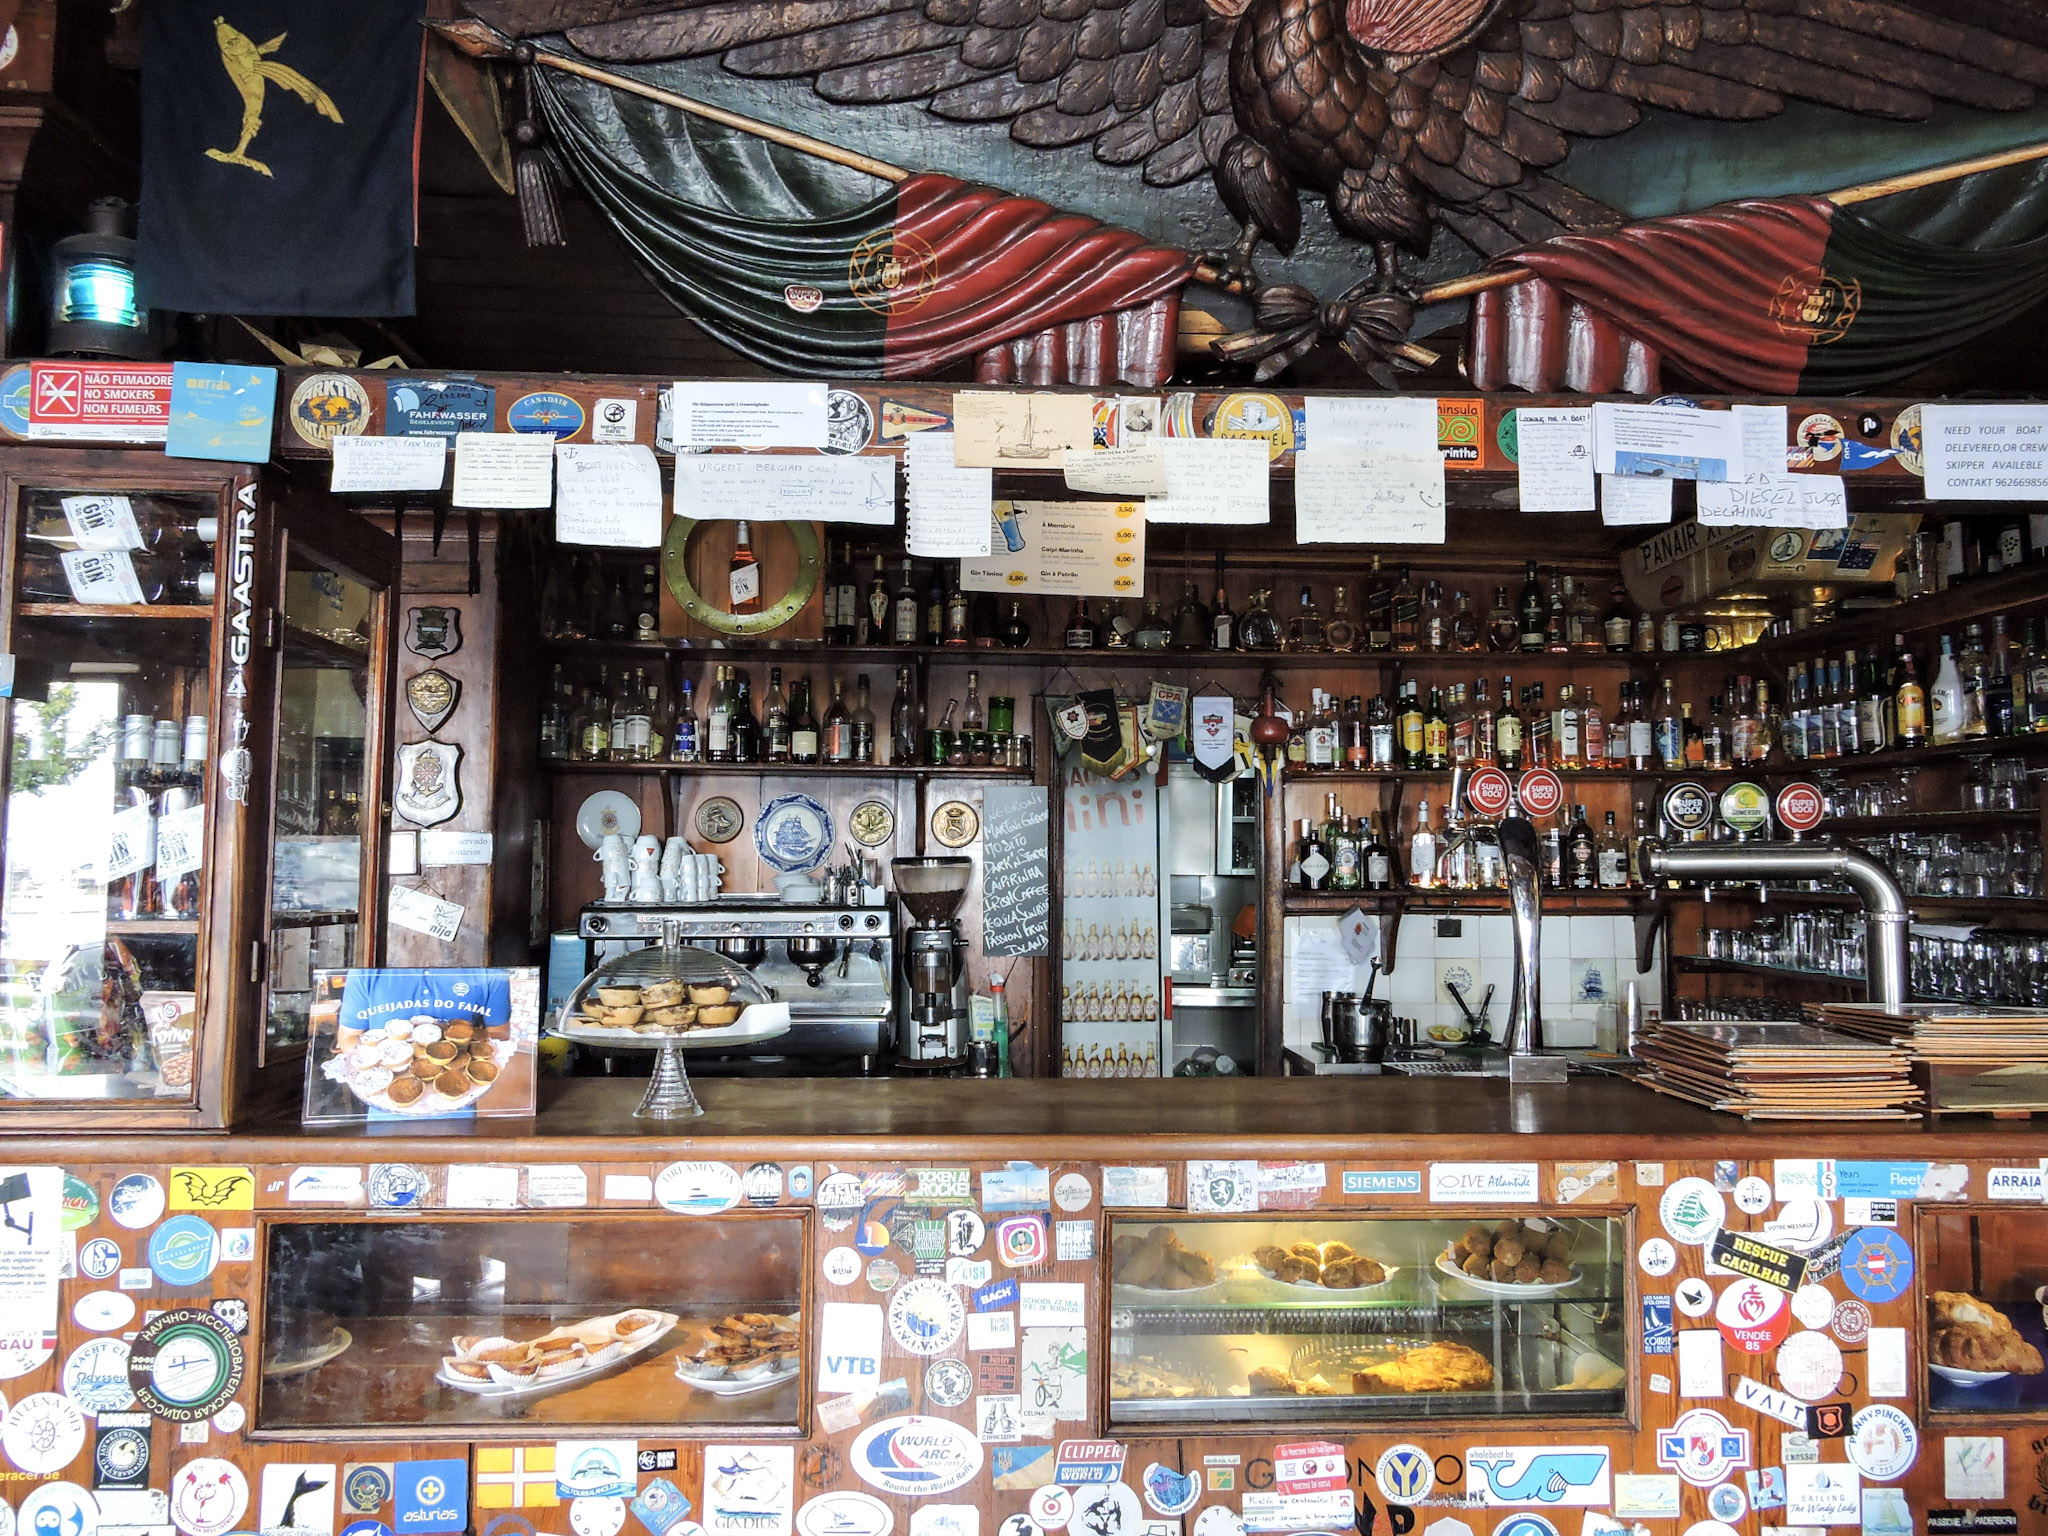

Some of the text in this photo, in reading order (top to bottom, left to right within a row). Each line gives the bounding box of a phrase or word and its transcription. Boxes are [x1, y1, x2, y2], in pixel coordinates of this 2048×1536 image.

[85, 373, 109, 385] NÃO
[84, 390, 156, 400] NO SMOKERS
[523, 396, 569, 407] CANADAIR
[83, 404, 162, 415] NON FUMEURS
[409, 411, 488, 420] FAHRWASSER
[1944, 425, 2043, 435] NEED YOUR BOAT
[2020, 442, 2048, 452] CREW
[698, 463, 743, 473] URGENT
[1946, 460, 2043, 470] SKIPPER AVAILEBLE
[1947, 477, 1993, 488] CONTAKT
[1730, 487, 1795, 505] DIESEL
[82, 503, 105, 529] GIN
[81, 557, 105, 584] GIN
[231, 483, 258, 664] GAASTRA
[970, 569, 981, 577] Gin
[1158, 690, 1183, 702] CPA
[1481, 782, 1503, 791] SUPER
[1531, 783, 1553, 793] SUPER
[1482, 790, 1502, 798] BOCK
[1532, 791, 1553, 799] BOCK
[1678, 799, 1703, 808] SUPER
[1790, 799, 1814, 807] SUPER
[1678, 806, 1702, 815] BOCK
[1791, 806, 1813, 814] BOCK
[983, 866, 1044, 896] CAIPIRINHA
[984, 926, 1022, 950] PASSION
[356, 998, 492, 1020] QUEIJADAS DO FAIAL
[1838, 1169, 1861, 1180] Years
[1890, 1173, 1922, 1185] Fleet
[1347, 1176, 1418, 1189] SIEMENS
[1488, 1173, 1531, 1189] Atlantide
[1733, 1236, 1789, 1268] RESCUE
[1720, 1252, 1791, 1288] CACILHAS
[981, 1286, 1012, 1304] BACH
[1022, 1297, 1051, 1305] SCHOOL
[1064, 1299, 1079, 1307] SEA
[1734, 1327, 1771, 1340] VENDÉE
[1644, 1337, 1671, 1346] COURSE
[1745, 1341, 1760, 1351] 85
[72, 1344, 109, 1370] YACHT
[137, 1311, 243, 1420] НАУЧНО-ИССЛЕДОВАТЕЛЬСКАЯ ОДИССЕЯ
[826, 1355, 877, 1375] VTB
[9, 1396, 82, 1433] HELENA 1913
[900, 1435, 953, 1447] WORLD
[919, 1449, 951, 1460] ARC
[1064, 1443, 1121, 1459] CLIPPER
[1469, 1450, 1514, 1460] whaleboat.be
[1061, 1466, 1104, 1475] ROUND THE
[883, 1480, 911, 1493] Round
[930, 1478, 955, 1492] World
[955, 1462, 975, 1482] Rally
[1060, 1472, 1103, 1481] WORLD
[1800, 1494, 1846, 1502] SAILING
[403, 1507, 458, 1522] asturias
[1790, 1503, 1857, 1515] The Windy Lady
[715, 1515, 780, 1530] GLADIUS
